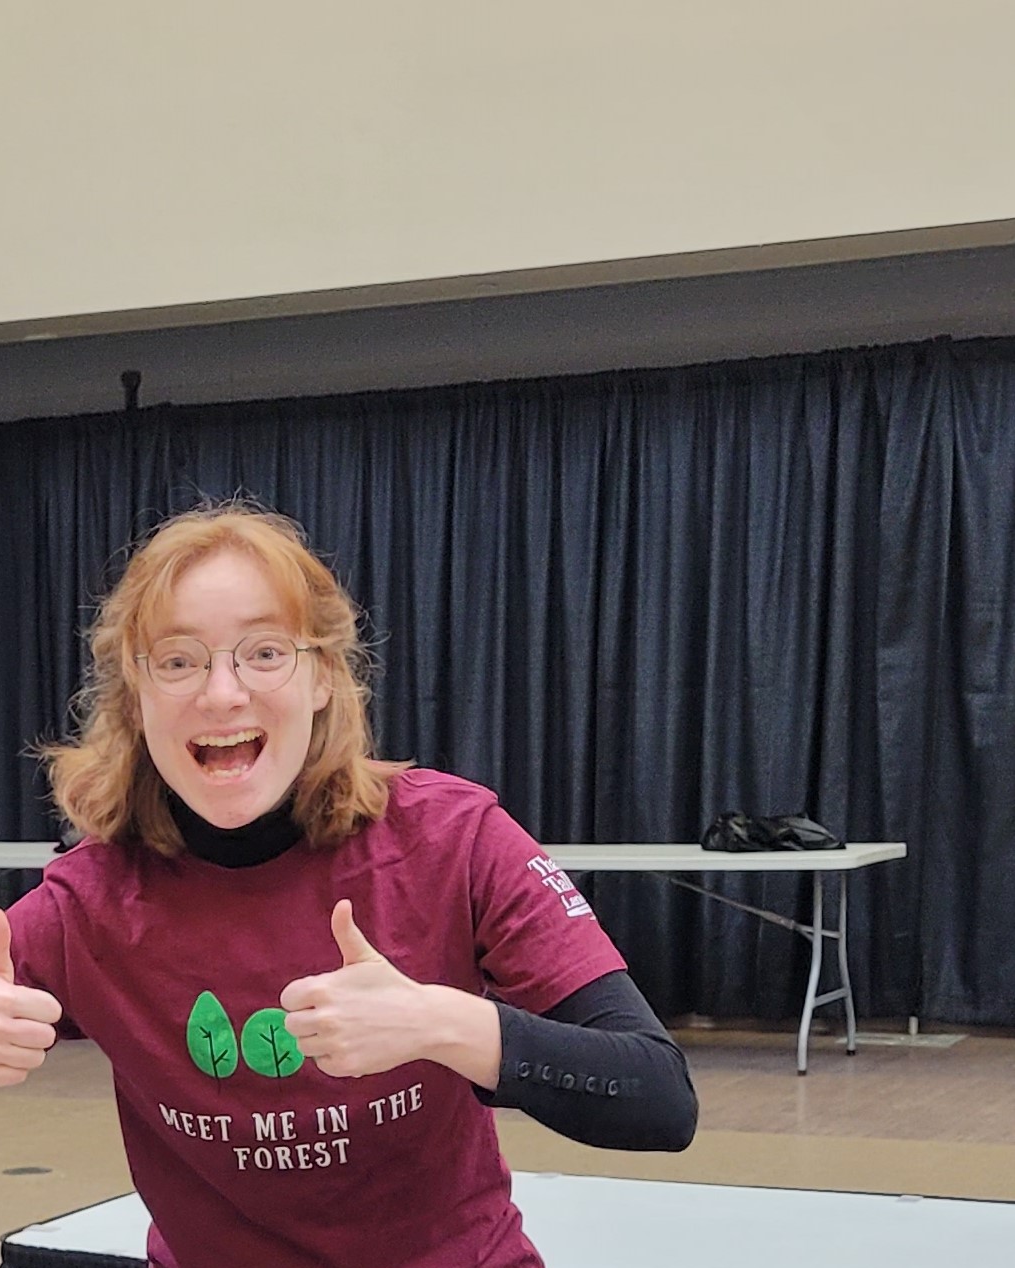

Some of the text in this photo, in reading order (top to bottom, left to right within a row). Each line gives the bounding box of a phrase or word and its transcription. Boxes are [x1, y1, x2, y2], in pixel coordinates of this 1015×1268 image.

[158, 1083, 423, 1142] MEET ME IN THE
[233, 1138, 351, 1172] FOREST
